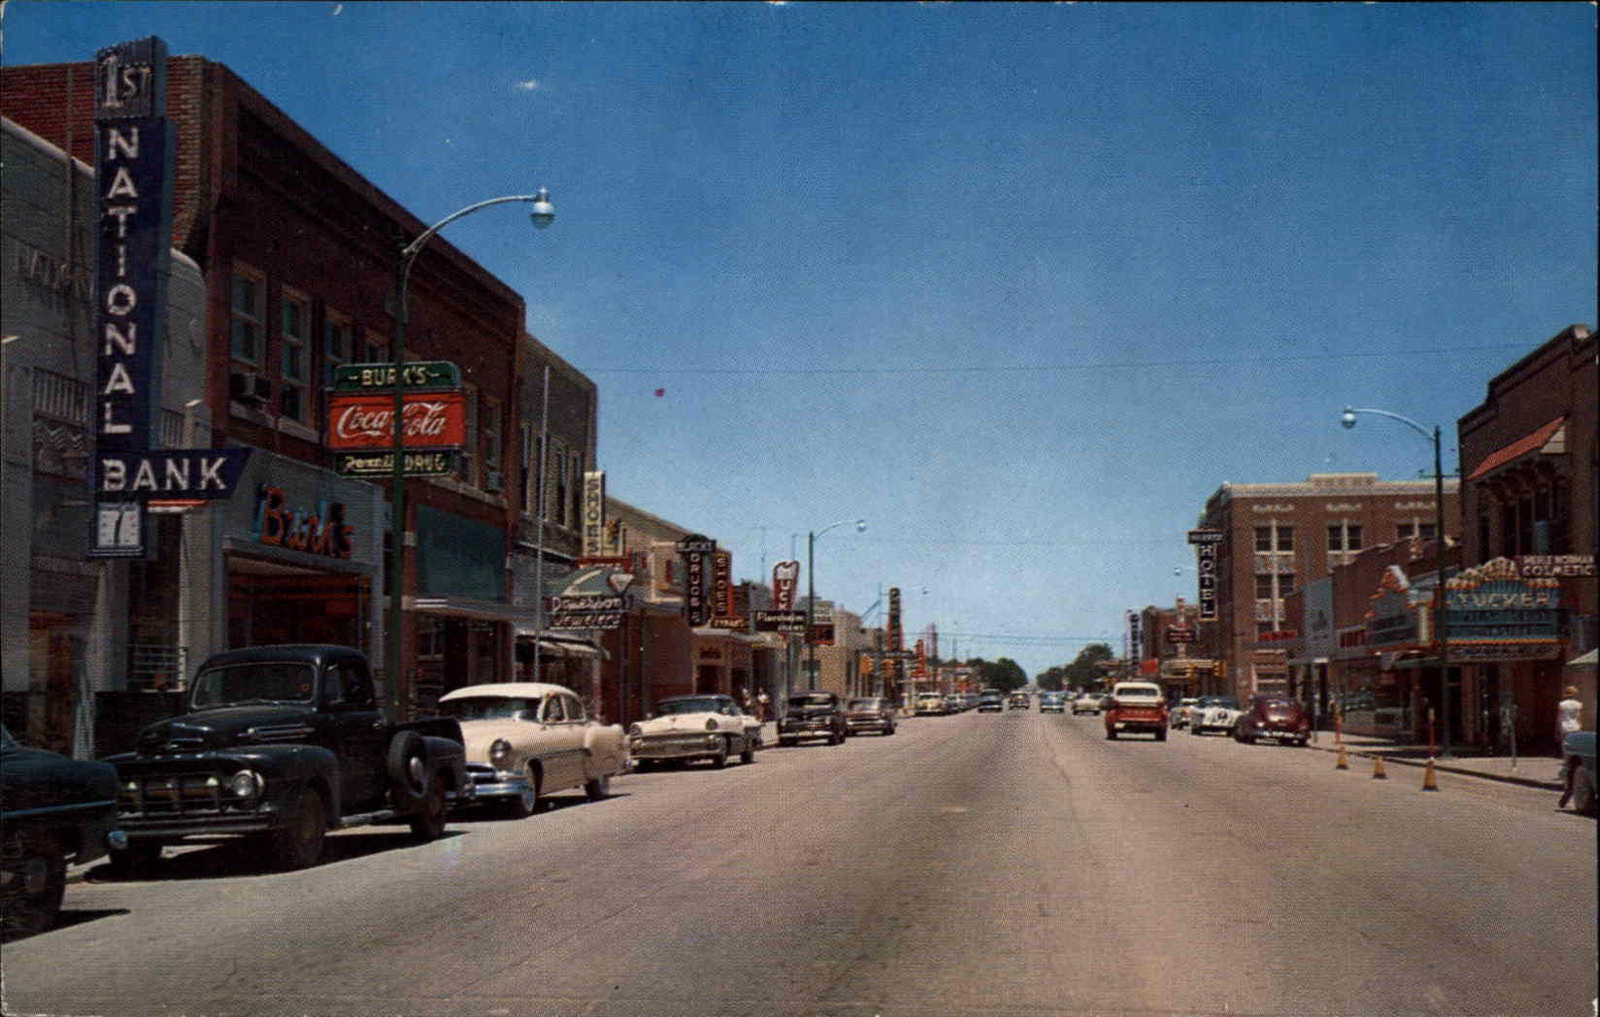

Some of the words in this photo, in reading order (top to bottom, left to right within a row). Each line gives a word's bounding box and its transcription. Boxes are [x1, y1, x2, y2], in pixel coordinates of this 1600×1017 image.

[104, 127, 140, 433] NATIONAL
[103, 458, 227, 492] BANK
[403, 454, 446, 471] DRUG
[1200, 545, 1214, 615] HOTEL
